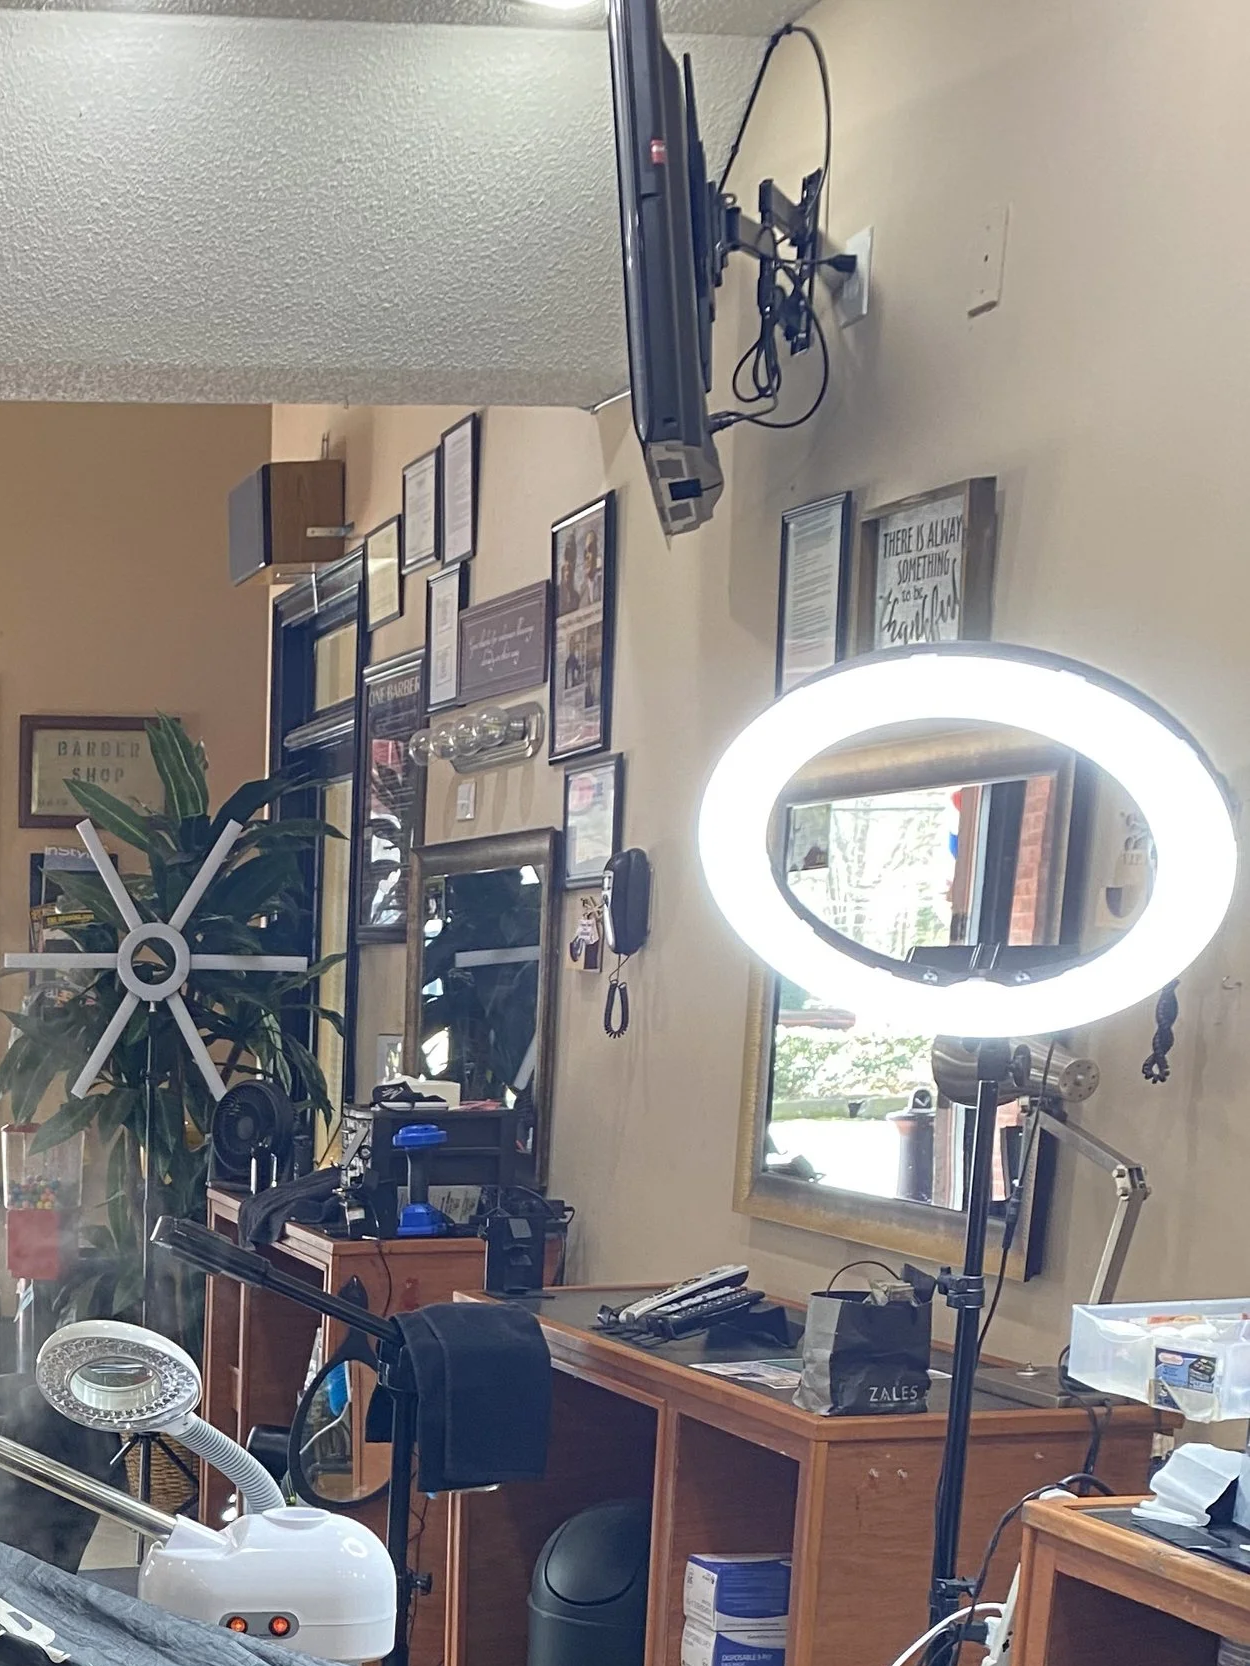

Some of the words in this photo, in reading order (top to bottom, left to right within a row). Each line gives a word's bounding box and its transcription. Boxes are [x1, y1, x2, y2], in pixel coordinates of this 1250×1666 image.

[883, 526, 913, 559] THERE
[916, 523, 925, 552] IS
[927, 514, 963, 549] ALWAY
[897, 550, 951, 585] SOMETHING
[58, 741, 140, 758] BARBER
[71, 767, 124, 783] SHOP
[869, 1385, 918, 1402] ZALES
